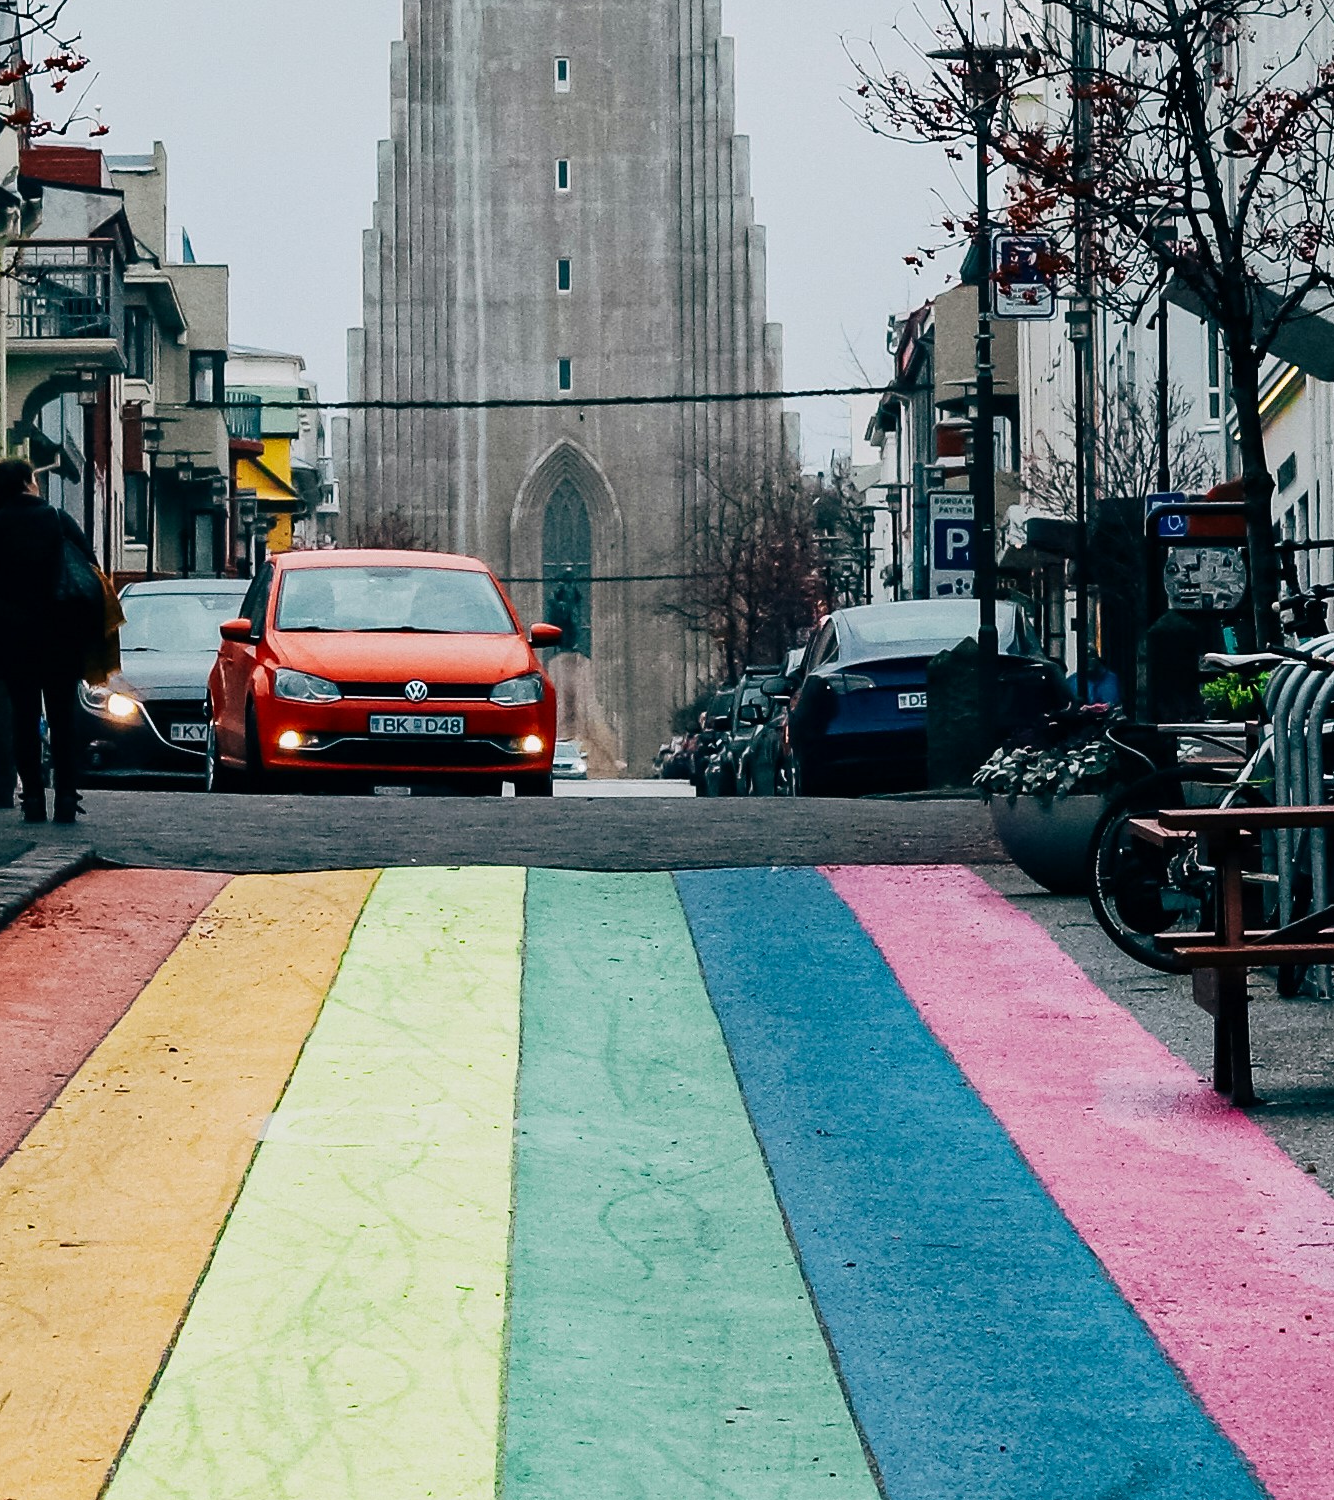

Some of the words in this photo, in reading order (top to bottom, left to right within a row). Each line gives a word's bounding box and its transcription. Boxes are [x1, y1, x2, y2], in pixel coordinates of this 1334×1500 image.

[947, 528, 970, 560] P
[383, 716, 409, 733] BK
[424, 717, 461, 734] D48
